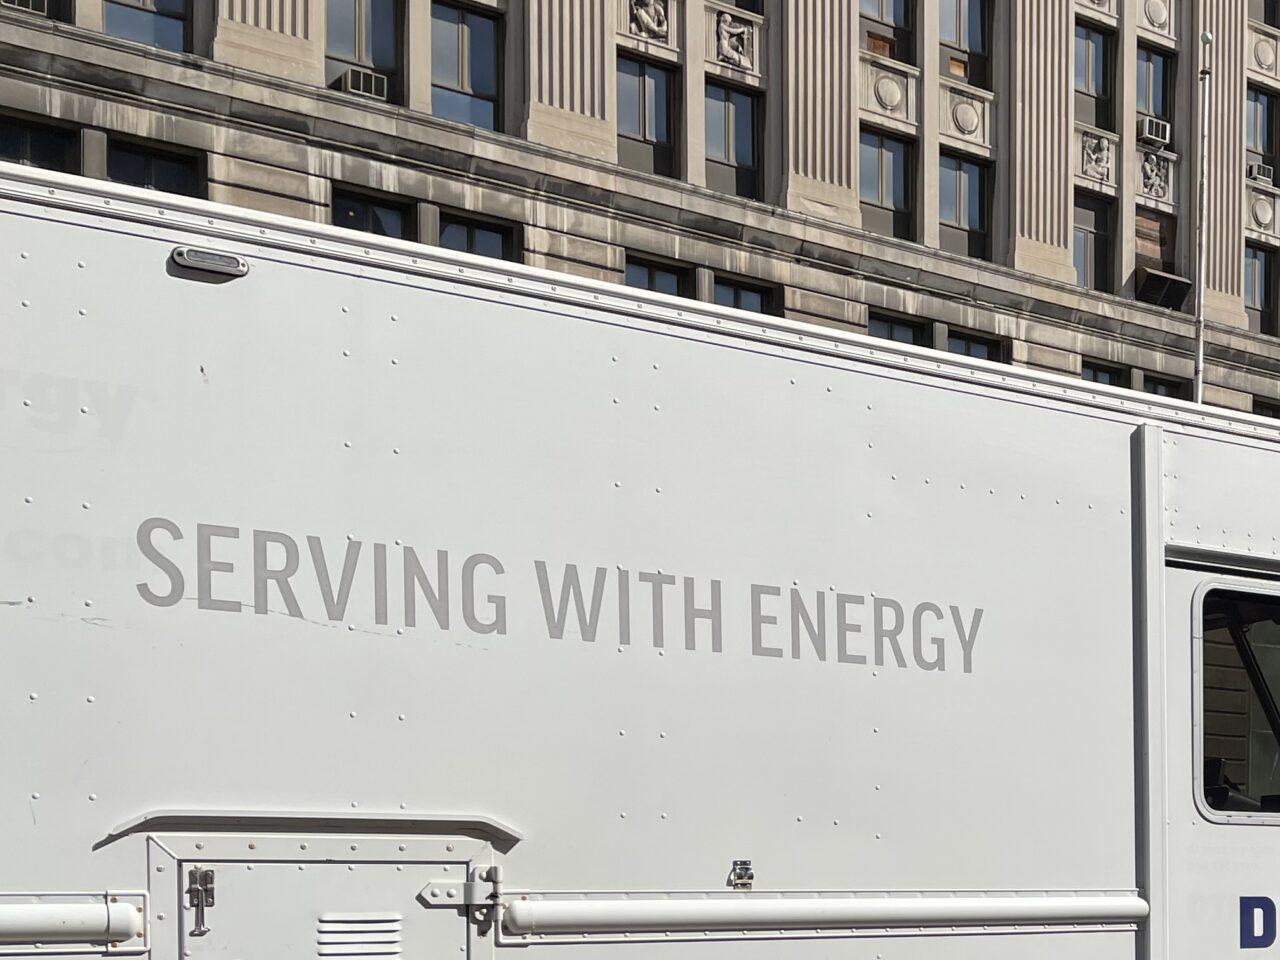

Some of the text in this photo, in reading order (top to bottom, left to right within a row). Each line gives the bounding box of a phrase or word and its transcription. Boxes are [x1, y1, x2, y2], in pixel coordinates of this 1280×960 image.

[135, 516, 985, 674] SERVING WITH ENERGY
